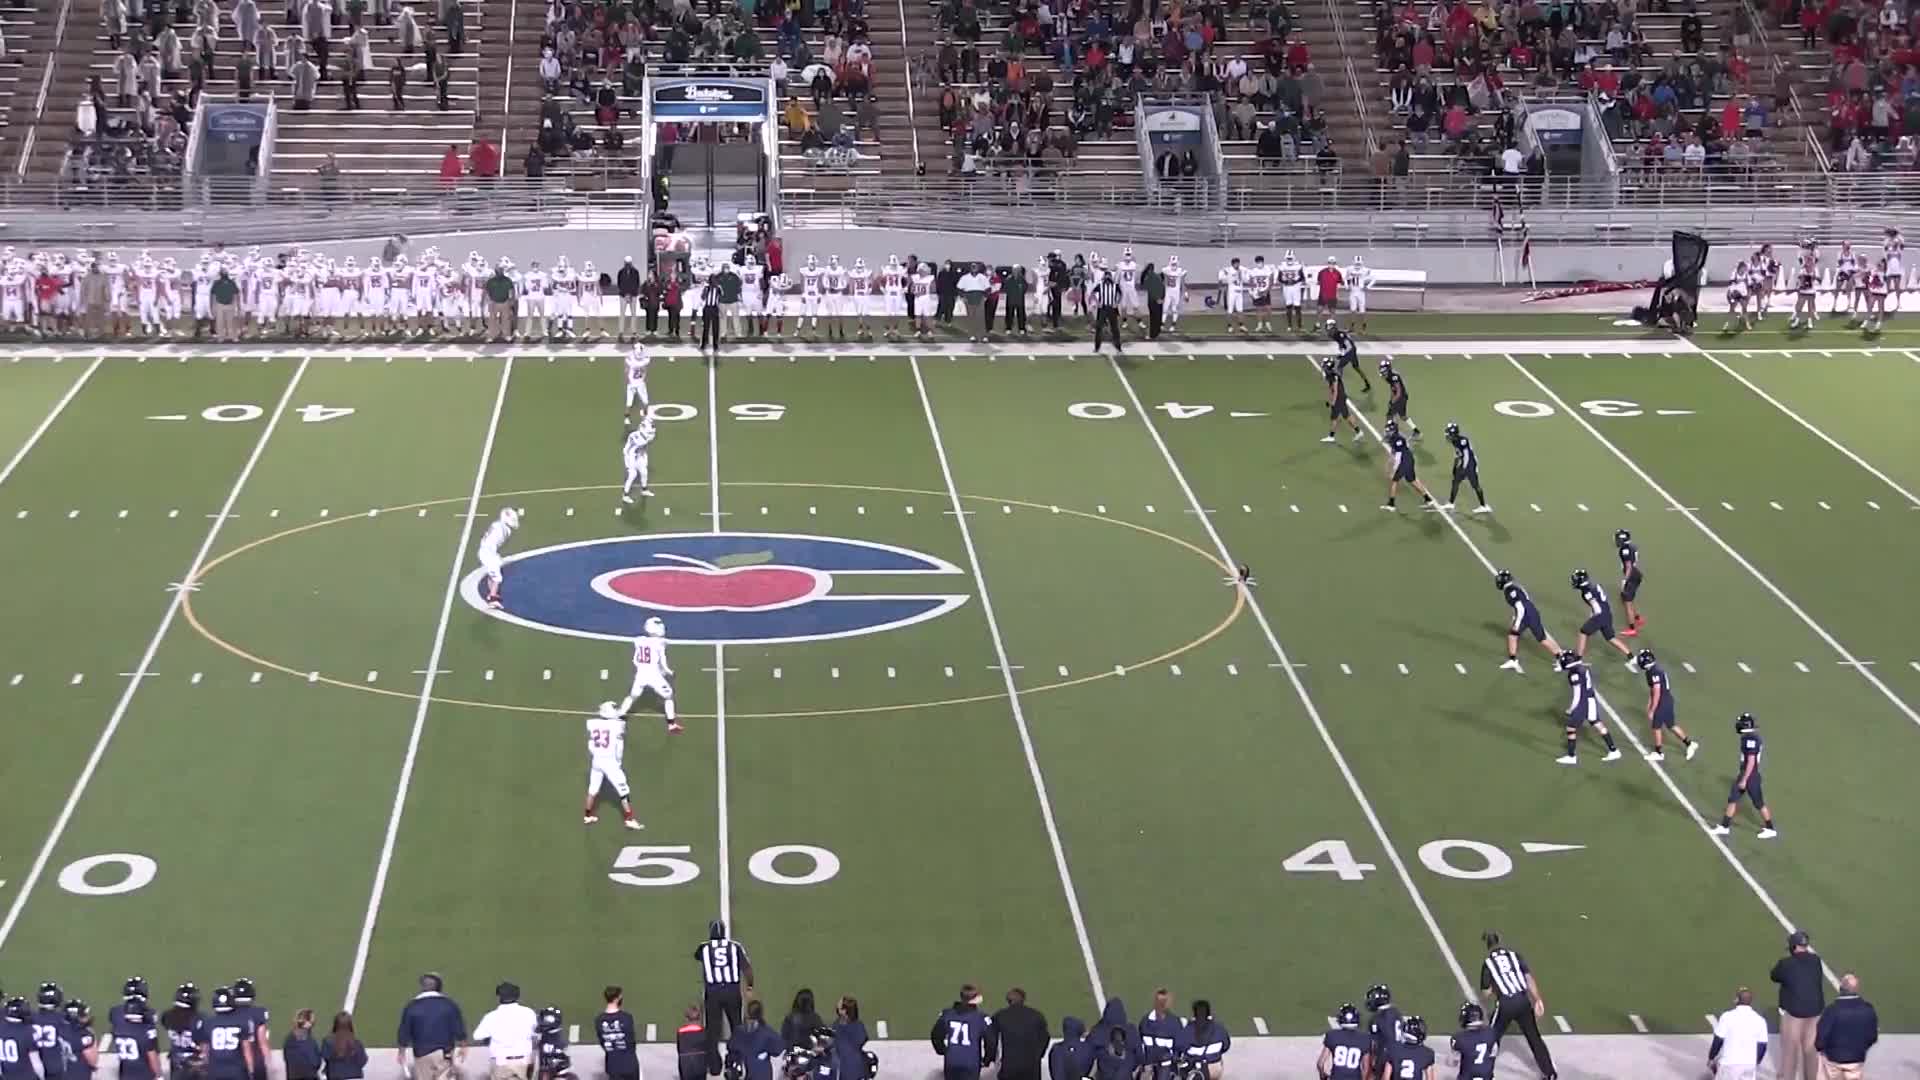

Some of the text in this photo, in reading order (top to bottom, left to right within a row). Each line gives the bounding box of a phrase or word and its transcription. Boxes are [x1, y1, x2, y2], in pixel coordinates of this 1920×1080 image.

[592, 729, 610, 749] 23
[714, 947, 728, 966] S
[211, 1026, 241, 1050] 85
[949, 1020, 972, 1046] 71
[114, 1036, 140, 1060] 33
[1333, 1045, 1362, 1069] 80
[1474, 1043, 1488, 1064] 7
[1401, 1059, 1415, 1078] 2
